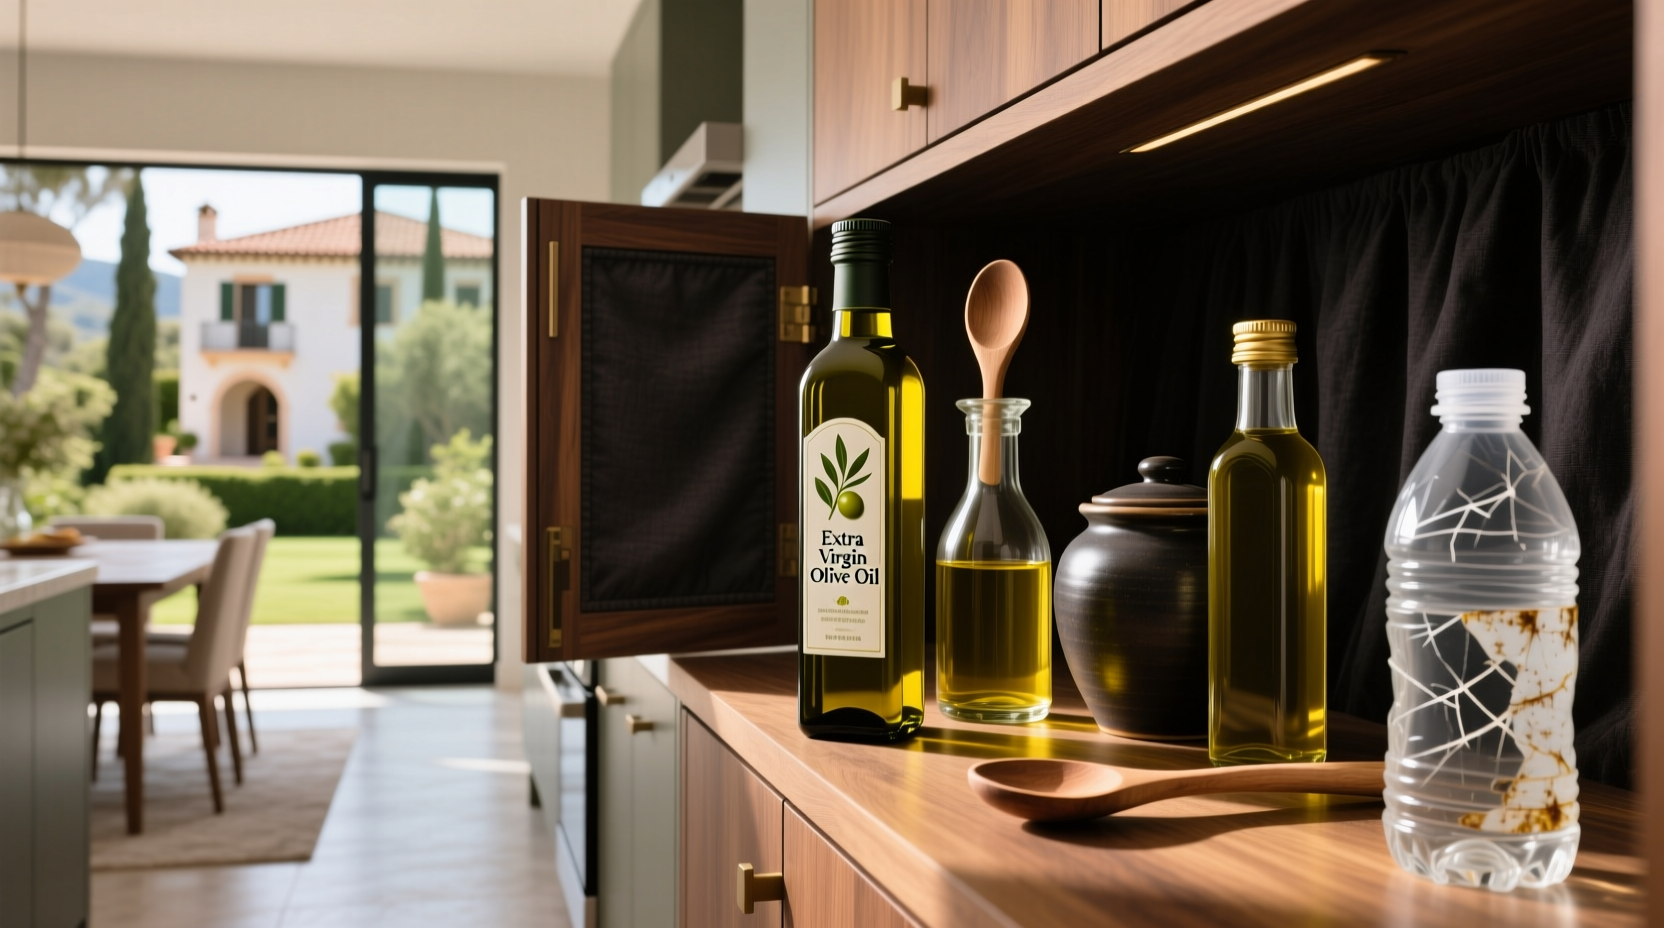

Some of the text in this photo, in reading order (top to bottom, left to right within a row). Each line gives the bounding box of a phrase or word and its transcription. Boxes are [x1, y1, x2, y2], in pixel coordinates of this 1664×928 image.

[822, 530, 864, 546] Extra
[819, 548, 867, 569] Virgin
[810, 567, 879, 585] Olive Oil
